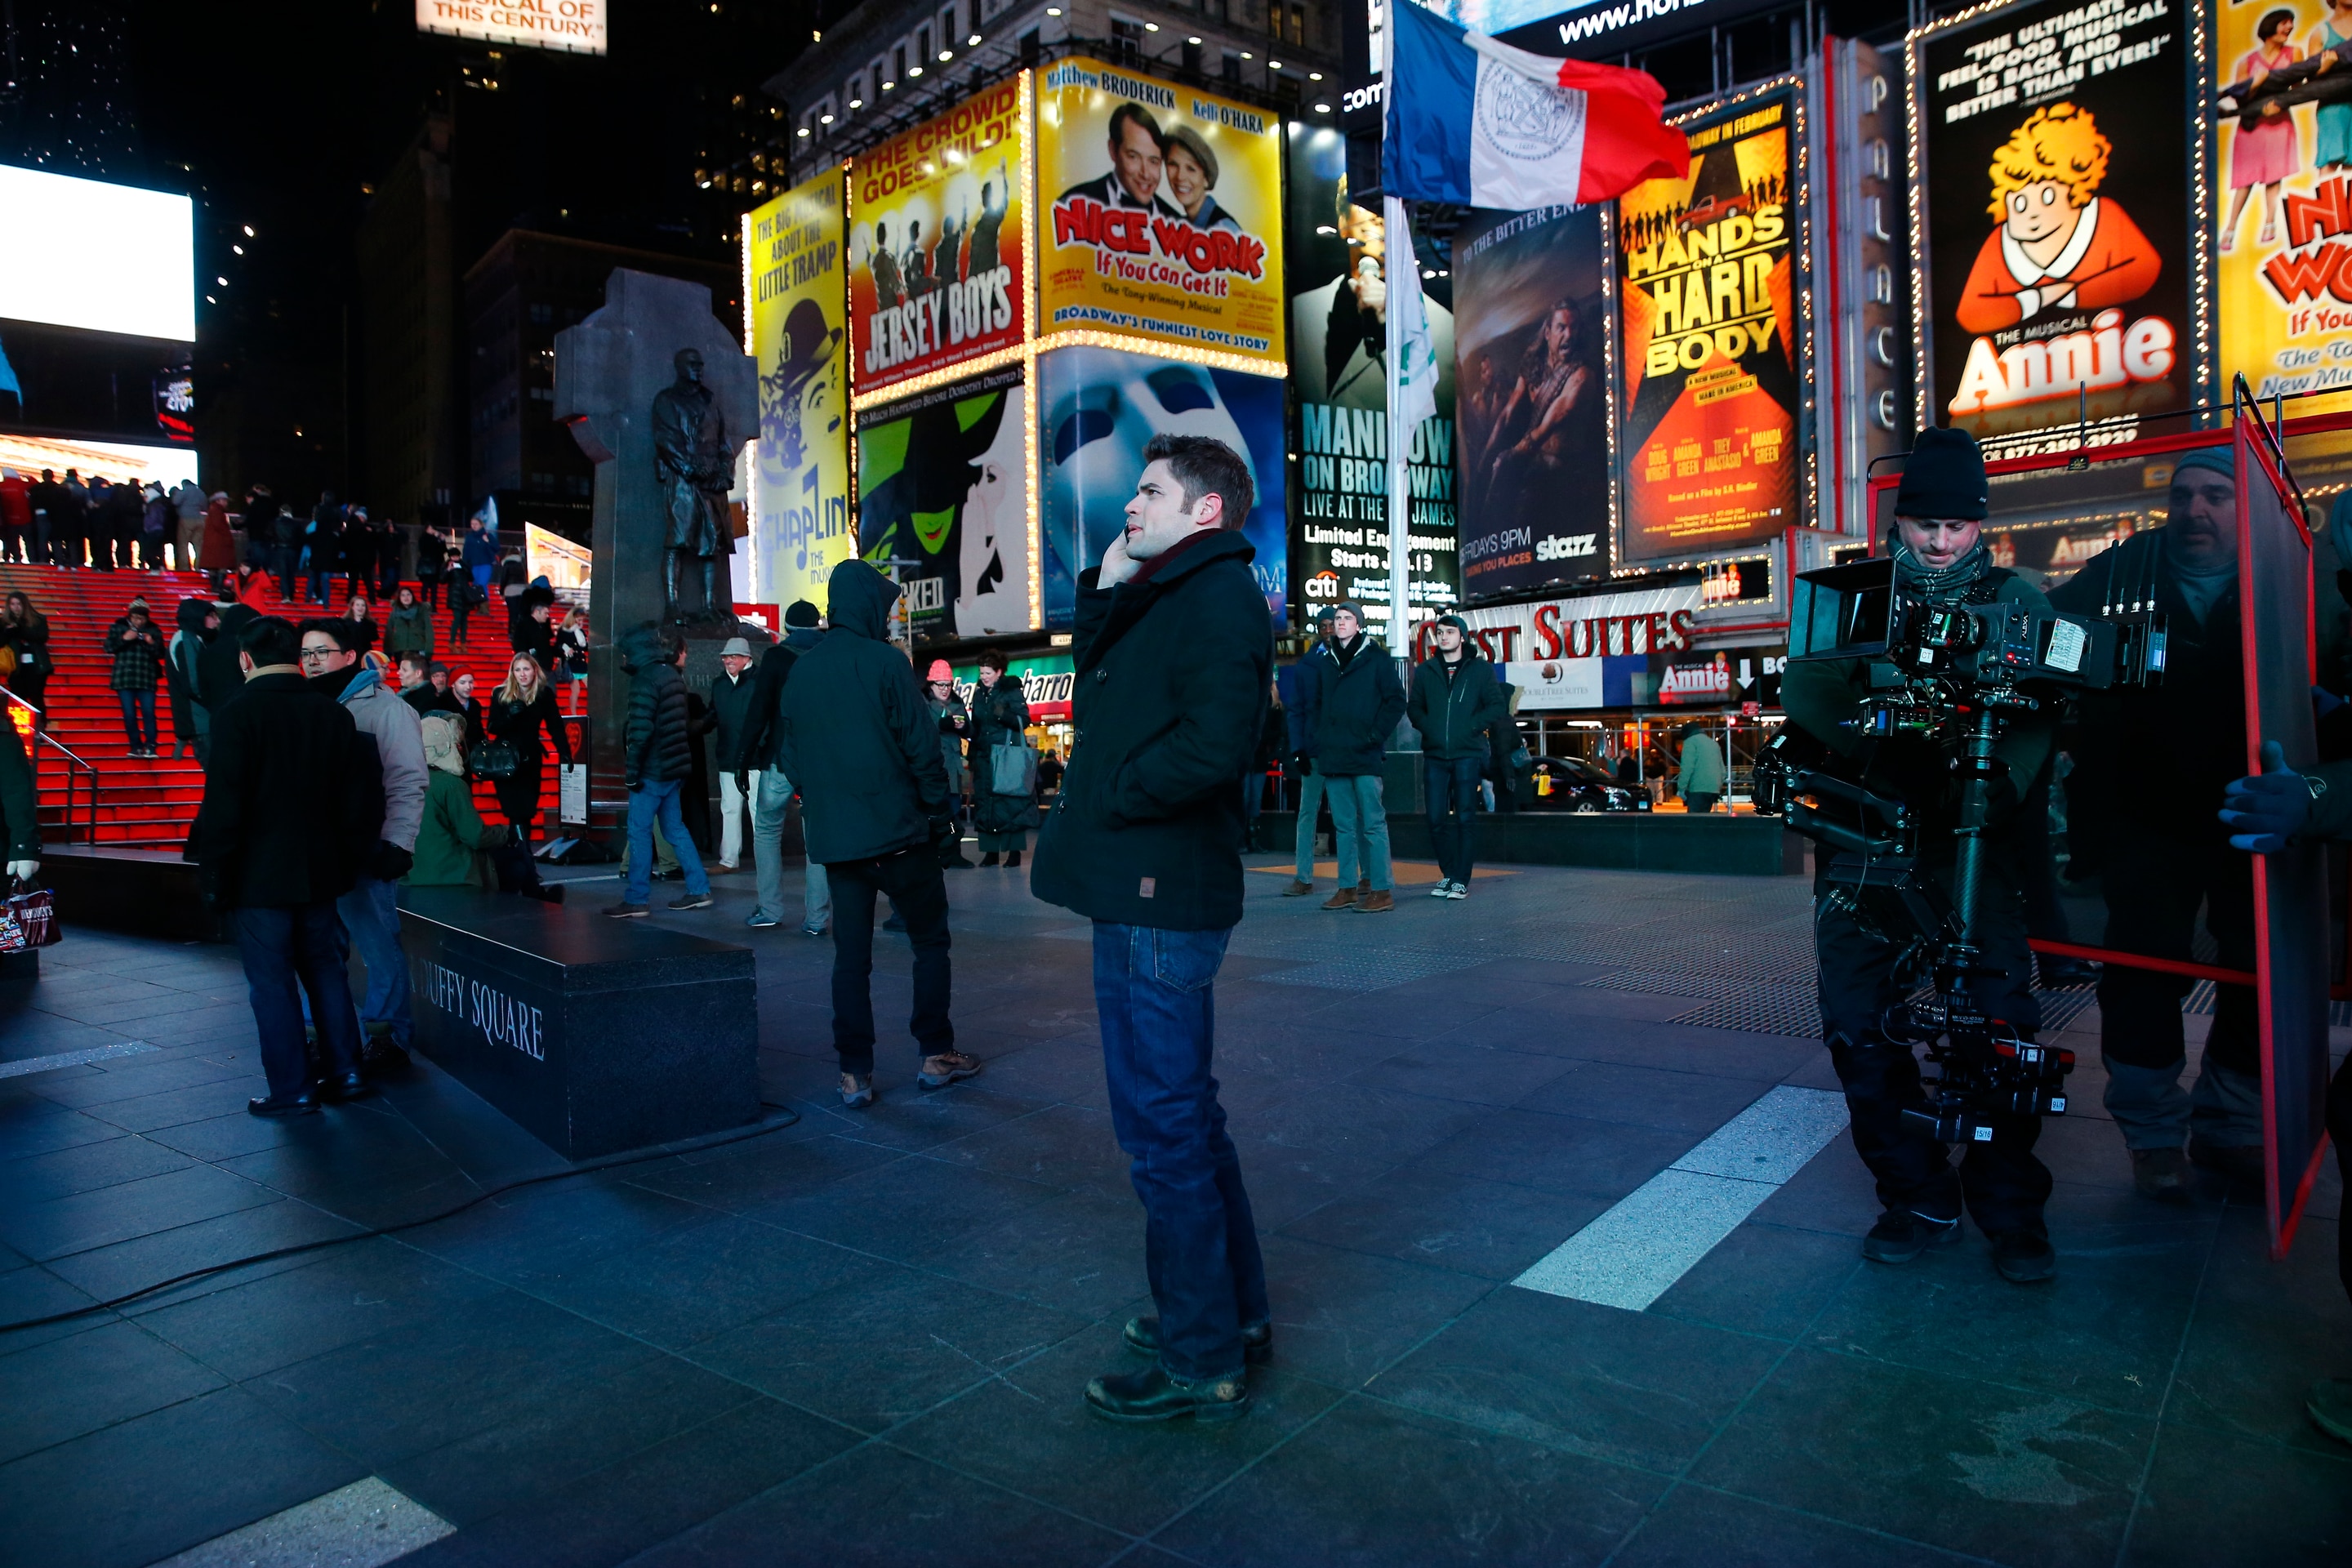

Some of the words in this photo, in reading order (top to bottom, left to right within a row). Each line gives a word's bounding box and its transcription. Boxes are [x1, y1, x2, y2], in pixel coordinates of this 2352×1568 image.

[434, 2, 484, 21] THIS
[559, 1, 594, 18] OF
[2017, 0, 2125, 46] ULTIMATE
[1938, 37, 2057, 92] FEEL-GOOD
[2063, 0, 2169, 49] MUSICAL
[1976, 74, 1998, 96] IS
[2003, 51, 2063, 87] BACK
[2068, 33, 2121, 65] AND
[1047, 65, 1098, 92] Matthew
[1101, 71, 1175, 109] BRODERICK
[1945, 85, 2017, 124] BETTER
[2022, 63, 2085, 98] THAN
[915, 87, 1015, 153] CROWD
[1193, 100, 1218, 122] Kelli
[1221, 107, 1264, 135] O'HARA
[1722, 121, 1733, 140] IN
[1735, 103, 1784, 136] FEBRUARY
[863, 156, 933, 204] GOES
[758, 217, 772, 243] THE
[772, 229, 801, 264] ABOUT
[804, 219, 821, 246] THE
[1053, 198, 1152, 256] NICE
[1151, 216, 1267, 281] WORK
[1472, 229, 1494, 256] THE
[1495, 208, 1548, 243] BITTER
[1628, 204, 1784, 279] HANDS
[759, 263, 790, 303] LITTLE
[793, 240, 837, 286] TRAMP
[1096, 250, 1111, 274] If
[1116, 256, 1146, 280] You
[1148, 262, 1179, 285] Can
[1181, 272, 1212, 295] Get
[1214, 277, 1227, 296] It
[1693, 256, 1712, 270] ON
[1714, 254, 1724, 264] A
[1867, 75, 1895, 431] PALACE
[1101, 282, 1120, 296] The
[1121, 285, 1186, 310] Tony-Winning
[1187, 300, 1222, 315] Musical
[1654, 252, 1774, 337] HARD
[865, 288, 942, 375] JERSEY
[948, 264, 1012, 345] BOYS
[1054, 305, 1138, 327] BROADWAY'S
[1143, 318, 1197, 339] FUNNIEST
[1200, 328, 1231, 345] LOVE
[1234, 336, 1269, 351] STORY
[1994, 329, 2020, 346] THE
[2024, 315, 2087, 341] MUSICAL
[2292, 310, 2310, 336] If
[1646, 315, 1777, 379] BODY
[1949, 308, 2176, 417] Annie
[2278, 350, 2319, 368] The
[2260, 375, 2310, 399] New
[1303, 403, 1452, 466] MANIOW
[1755, 445, 1779, 466] GREEN
[1303, 455, 1334, 490] ON
[1340, 458, 1453, 501] BROWAY
[761, 463, 846, 570] CHAPLIN
[1304, 492, 1334, 518] LIVE
[1339, 495, 1353, 519] AT
[1359, 497, 1384, 521] THE
[1412, 501, 1454, 527] JAMES
[810, 550, 824, 568] THE
[1304, 524, 1363, 546] Limited
[1366, 528, 1455, 552] Enggement
[1331, 548, 1379, 569] Starts
[1500, 526, 1531, 551] 9PM
[1536, 533, 1597, 562] starz
[1481, 559, 1497, 572] YOU
[1498, 551, 1532, 568] PLACES
[1304, 572, 1339, 598] citi
[1535, 605, 1693, 660] SUITES
[1022, 669, 1072, 702] barro
[1659, 662, 1731, 693] Annie
[420, 957, 465, 1018] DUFFY
[471, 980, 545, 1062] SQUARE
[1976, 1129, 1991, 1138] 15/16
